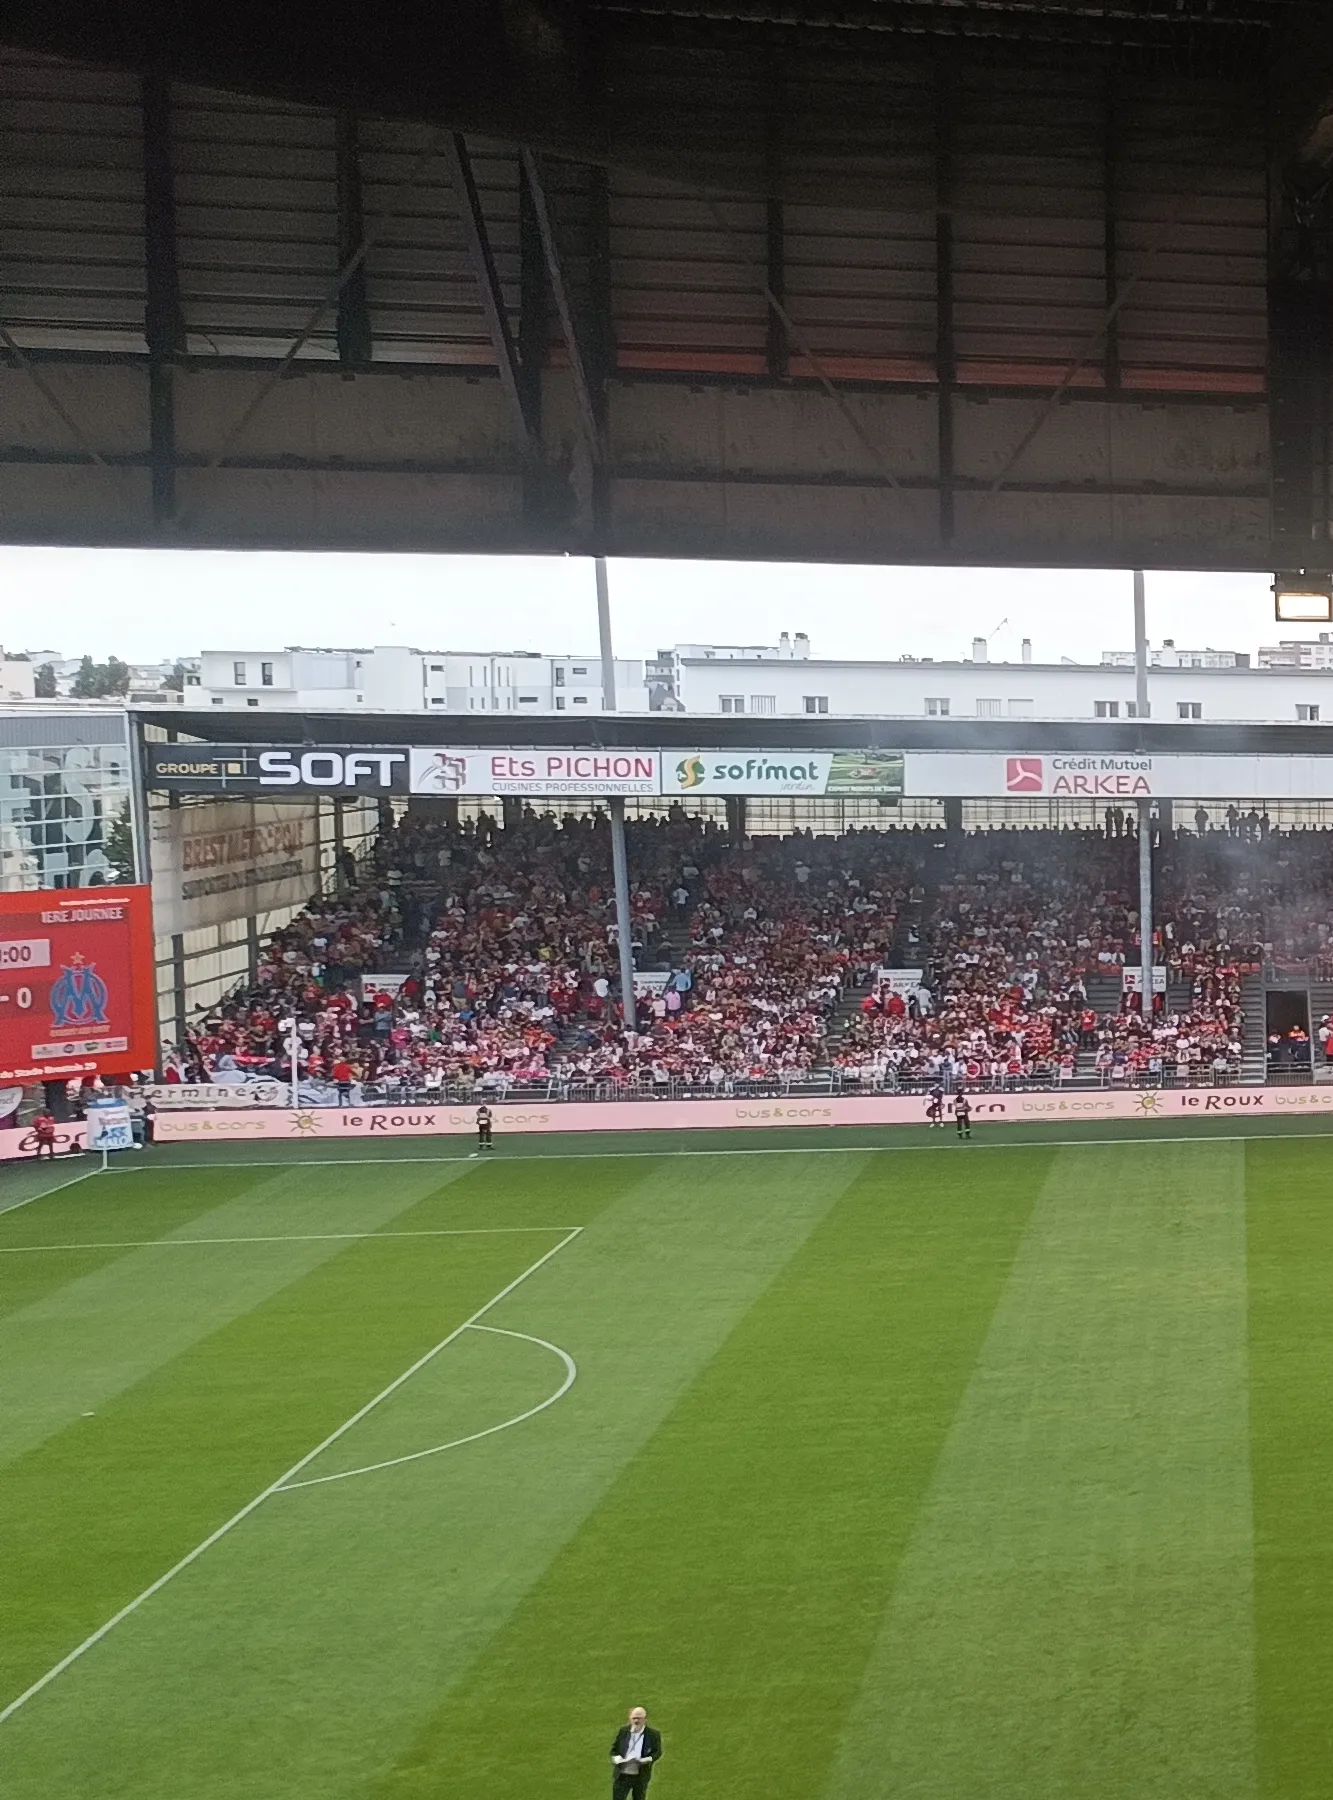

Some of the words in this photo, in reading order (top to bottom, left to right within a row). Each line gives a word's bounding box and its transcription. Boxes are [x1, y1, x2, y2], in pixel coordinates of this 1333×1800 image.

[156, 763, 218, 774] GROUPE
[259, 751, 406, 787] SOFT
[491, 756, 535, 777] Ets
[547, 757, 653, 778] PICHON
[1052, 757, 1097, 770] Crédit
[1100, 758, 1152, 771] Mutuel
[492, 782, 542, 792] CUISINES
[546, 783, 654, 793] PROFESSIONNELLES
[1053, 775, 1152, 795] ARKEA
[1182, 1095, 1200, 1107] le
[1205, 1094, 1264, 1110] Roux
[343, 1115, 364, 1127] le
[370, 1114, 436, 1131] Roux
